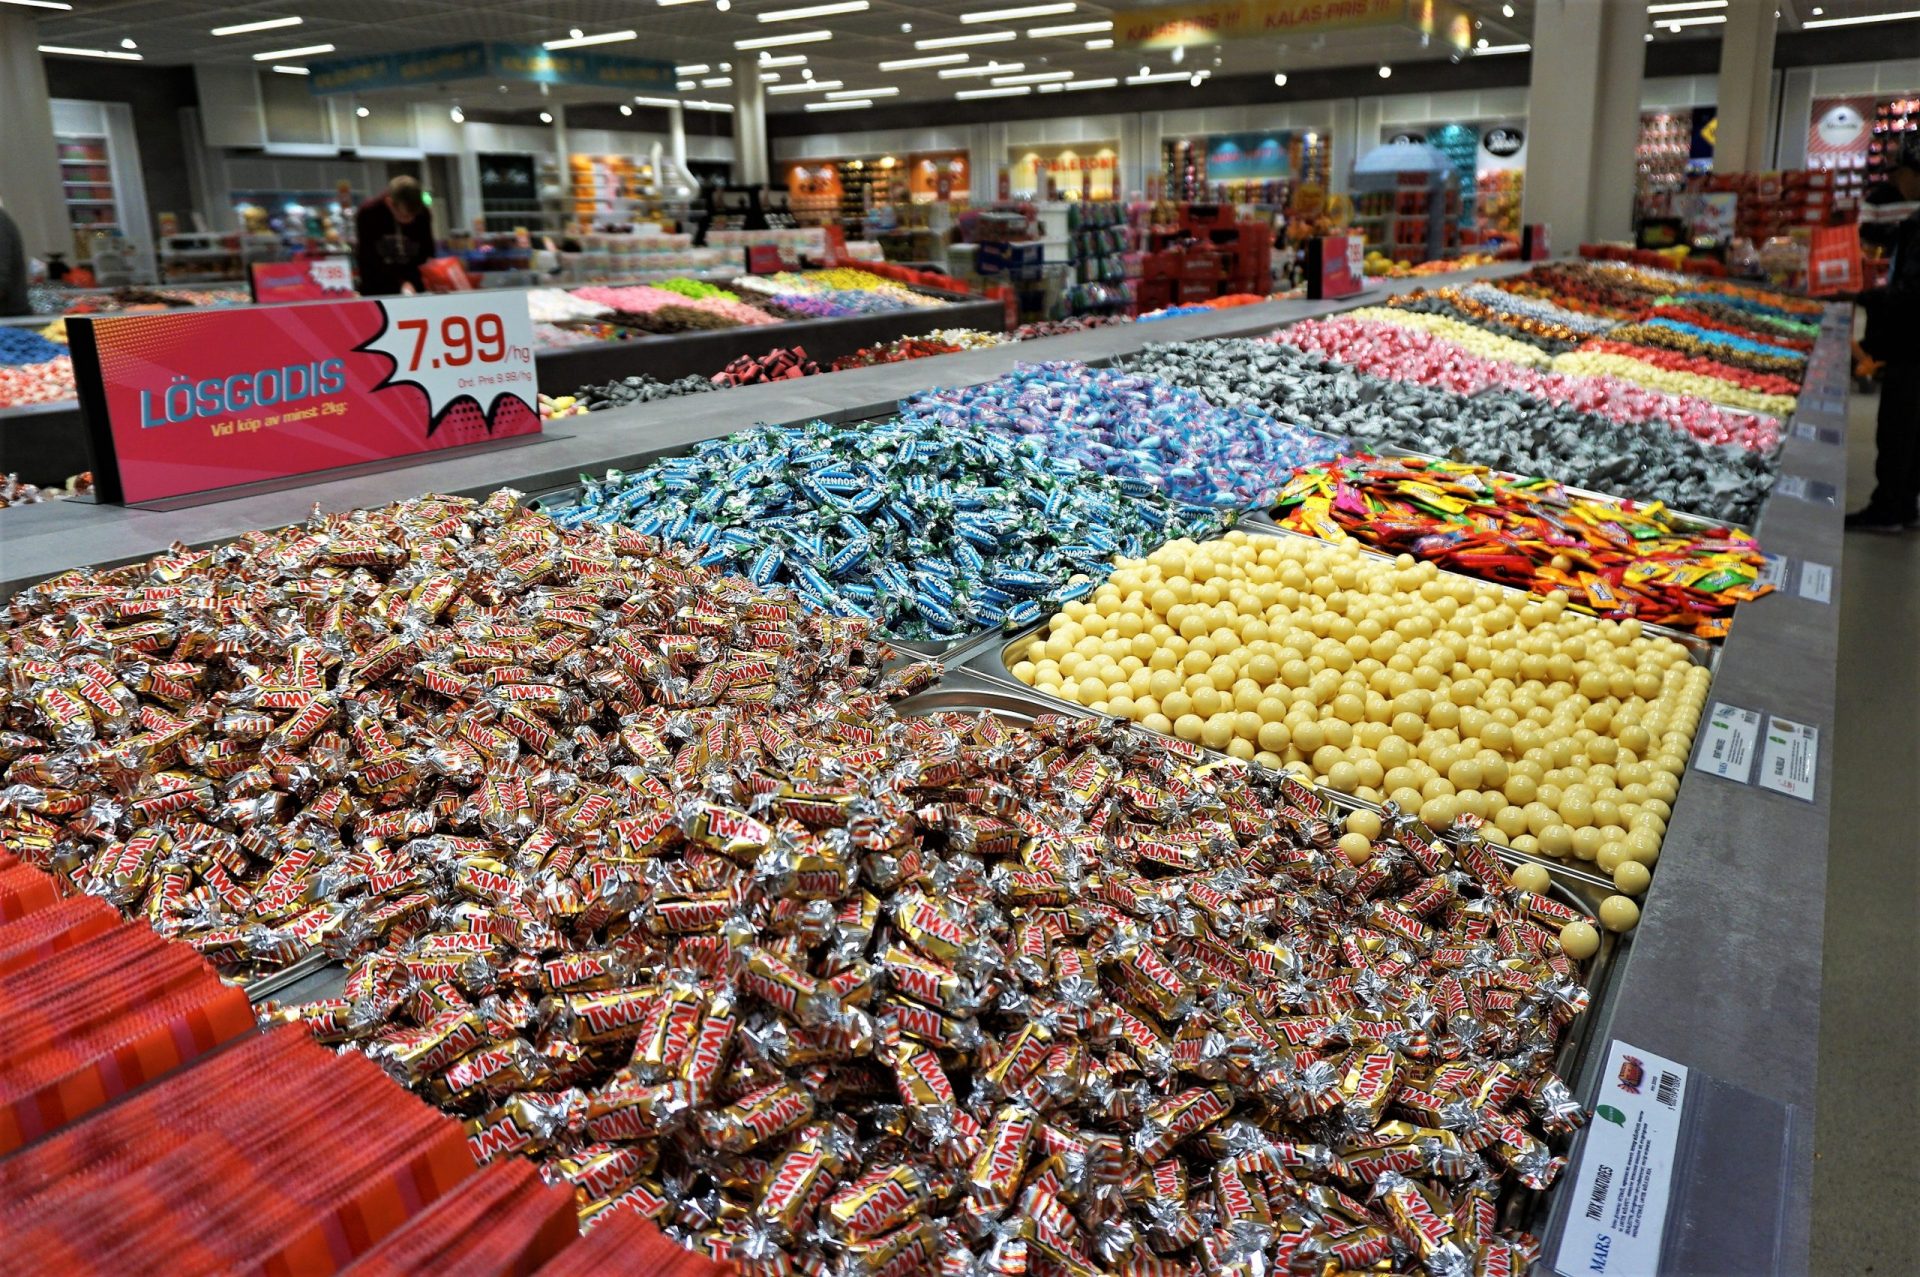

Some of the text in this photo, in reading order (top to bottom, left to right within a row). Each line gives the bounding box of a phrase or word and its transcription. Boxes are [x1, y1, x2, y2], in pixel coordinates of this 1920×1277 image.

[140, 358, 345, 429] LÖSGODIS
[210, 424, 233, 437] Vid
[237, 418, 261, 433] köp
[264, 415, 278, 425] av
[283, 407, 317, 423] minst
[429, 518, 462, 539] TWIX
[335, 551, 377, 564] TWIX
[617, 540, 649, 551] TWIX
[509, 552, 547, 574] TWIX
[568, 556, 608, 575] TWIX
[657, 563, 688, 586] TWIX
[120, 601, 159, 615] TWIX
[142, 587, 183, 598] TWIX
[753, 603, 787, 620] TWIX
[465, 644, 511, 658] TWIX
[549, 634, 573, 655] TWIX
[753, 631, 789, 646] TWIX
[83, 661, 118, 687] TWIX
[301, 647, 320, 688] TWIX
[360, 651, 402, 682] TWIX
[493, 668, 528, 683] TWIX
[610, 643, 643, 678] TWIX
[728, 662, 773, 680] TWIX
[79, 678, 123, 716] TWIX
[150, 670, 194, 699] TWIX
[424, 669, 463, 696] TWIX
[509, 684, 556, 701] TWIX
[46, 689, 84, 725] TWIX
[261, 691, 313, 707] TWIX
[138, 706, 173, 732] TWIX
[288, 701, 334, 741] TWIX
[466, 718, 498, 749] TWIX
[506, 713, 547, 755] TWIX
[838, 722, 873, 745] TWIX
[981, 717, 1001, 743] TWIX
[627, 728, 658, 757] TWIX
[708, 719, 727, 754] TWIX
[761, 723, 785, 752] TWIX
[1157, 737, 1196, 756] TWIX
[359, 761, 409, 786] TWIX
[923, 759, 960, 786] TWIX
[1070, 756, 1099, 789] TWIX
[137, 790, 200, 819] TWIX
[310, 786, 343, 817] TWIX
[573, 793, 613, 826] TWIX
[781, 802, 844, 823] TWIX
[1286, 780, 1323, 817] TWIX
[626, 810, 672, 850] TWIX
[707, 807, 763, 845] TWIX
[113, 835, 159, 877] TWIX
[1137, 841, 1185, 865] TWIX
[1403, 831, 1442, 873] TWIX
[1466, 846, 1501, 890] TWIX
[261, 849, 315, 895] TWIX
[368, 867, 417, 894] TWIX
[256, 878, 308, 914] TWIX
[1108, 877, 1136, 909] TWIX
[1189, 881, 1224, 913] TWIX
[1410, 886, 1450, 916] TWIX
[1528, 892, 1575, 918] TWIX
[657, 901, 729, 929] TWIX
[913, 903, 968, 944] TWIX
[1379, 907, 1424, 941] TWIX
[430, 933, 494, 950] TWIX
[1024, 923, 1044, 957] TWIX
[1434, 949, 1467, 962] TWIX
[406, 962, 459, 980] TWIX
[543, 958, 605, 987] TWIX
[1060, 949, 1082, 976] TWIX
[1135, 943, 1185, 996] TWIX
[1192, 939, 1242, 979] TWIX
[1504, 968, 1534, 988] TWIX
[582, 997, 650, 1033] TWIX
[1484, 990, 1519, 1010] TWIX
[664, 1002, 700, 1065] TWIX
[1115, 1006, 1158, 1047] TWIX
[415, 1023, 485, 1075] TWIX
[693, 1017, 734, 1083] TWIX
[444, 1049, 513, 1094] TWIX
[910, 1050, 953, 1103] TWIX
[1356, 1051, 1394, 1101] TWIX
[589, 1105, 652, 1141] TWIX
[744, 1093, 807, 1141] TWIX
[1170, 1090, 1230, 1136] TWIX
[991, 1118, 1032, 1185] TWIX
[1351, 1150, 1421, 1183] TWIX
[573, 1146, 648, 1199] TWIX
[763, 1149, 823, 1211] TWIX
[1153, 1159, 1179, 1195] TWIX
[1218, 1172, 1255, 1221] TWIX
[1586, 1164, 1613, 1221] TWIX MINIATURES
[845, 1181, 919, 1237] TWIX
[1400, 1190, 1453, 1245] TWIX
[1331, 1236, 1392, 1270] TWIX
[1590, 1234, 1611, 1274] MARS
